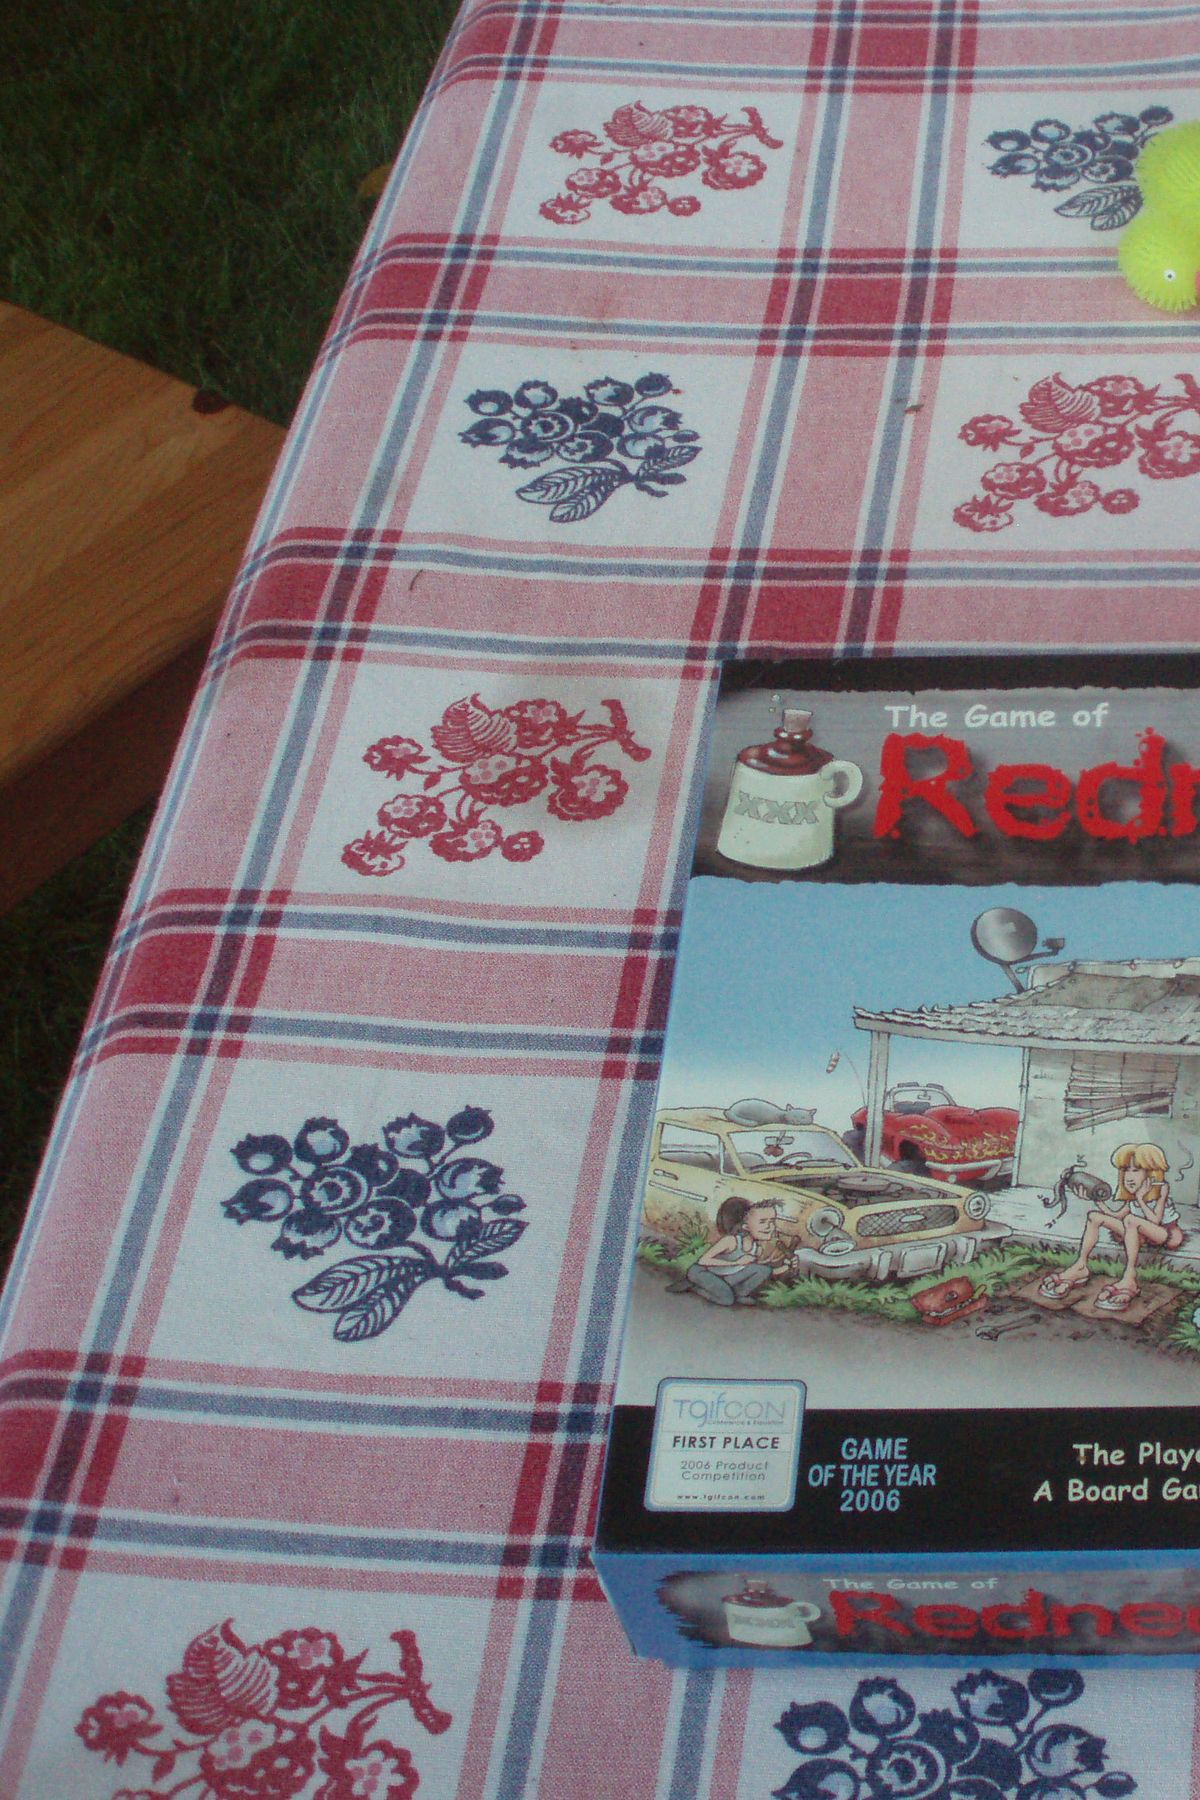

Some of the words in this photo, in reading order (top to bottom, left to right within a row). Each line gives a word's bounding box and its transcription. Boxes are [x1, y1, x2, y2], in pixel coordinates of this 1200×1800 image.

[884, 705, 948, 728] The
[965, 704, 1055, 729] Game
[1073, 703, 1109, 729] of
[733, 790, 819, 825] XXX
[672, 1436, 717, 1449] FIRST
[723, 1436, 780, 1449] PLACE
[841, 1437, 909, 1460] GAME
[680, 1460, 711, 1470] 2006
[716, 1460, 769, 1471] Product
[1072, 1443, 1125, 1466] The
[681, 1471, 766, 1482] Competition
[807, 1464, 835, 1487] OF
[839, 1464, 883, 1487] THE
[885, 1463, 937, 1486] YEAR
[840, 1489, 900, 1512] 2006
[1033, 1480, 1053, 1502] A
[1067, 1477, 1149, 1502] Board
[823, 1578, 874, 1591] The
[887, 1577, 960, 1591] Game
[971, 1577, 999, 1591] of
